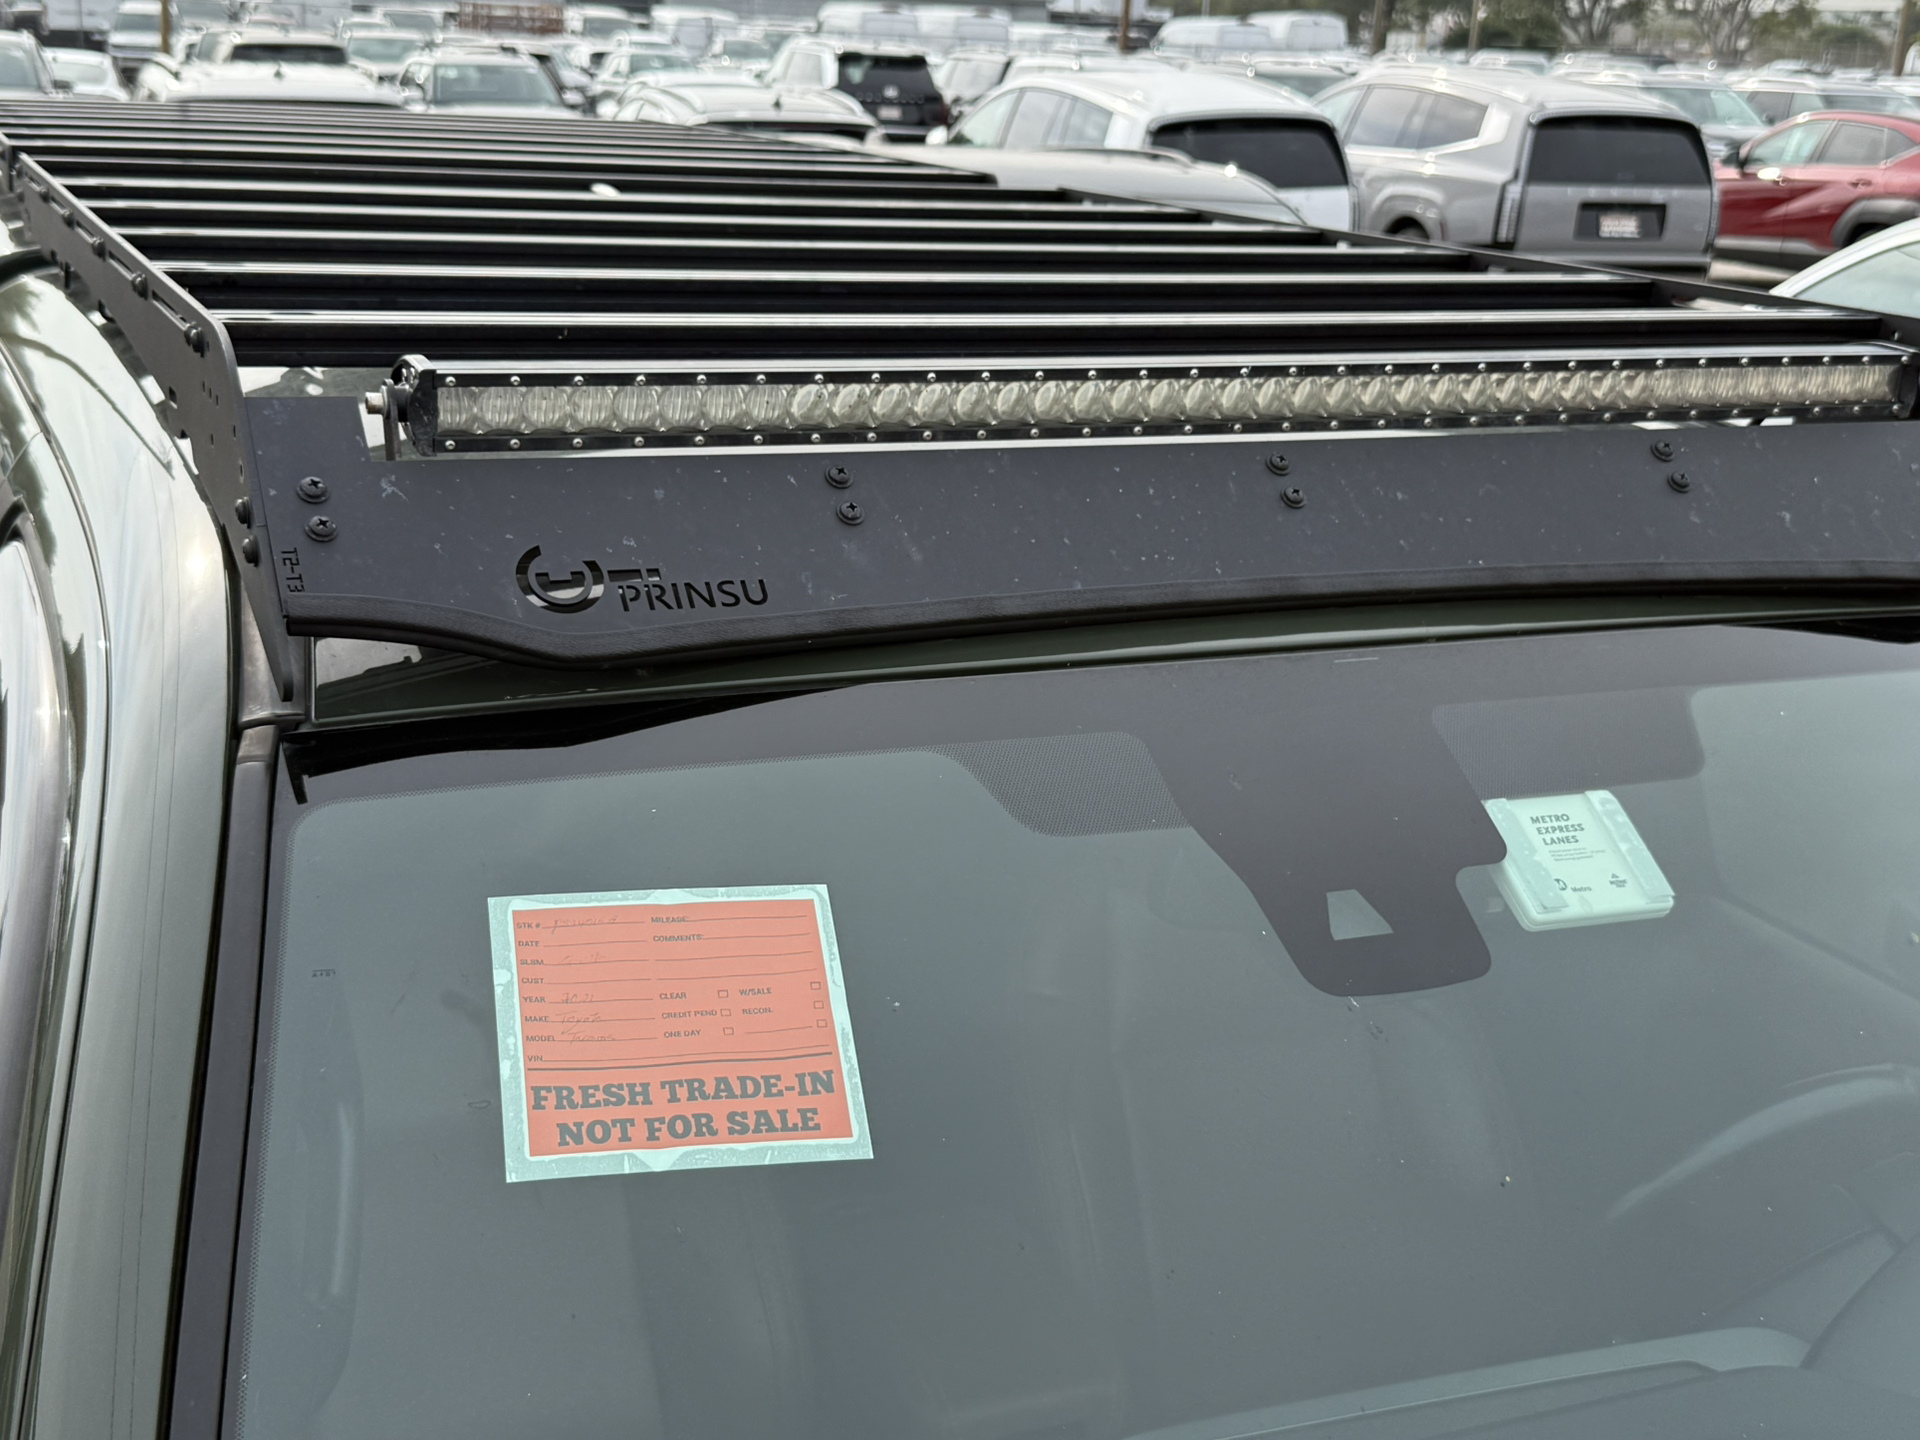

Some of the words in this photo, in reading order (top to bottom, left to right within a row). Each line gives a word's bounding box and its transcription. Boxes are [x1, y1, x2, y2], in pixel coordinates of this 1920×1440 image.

[617, 579, 769, 612] PRINSU
[1530, 813, 1570, 825] METRO
[1536, 823, 1585, 835] EXPRESS
[1542, 835, 1579, 846] LANES
[516, 921, 533, 929] STK
[659, 992, 687, 1000] CLEAR
[739, 987, 772, 996] W/SALE
[661, 1011, 692, 1019] CREDIT
[694, 1009, 717, 1017] PEND
[664, 1030, 682, 1038] ONE
[684, 1029, 701, 1037] DAY
[530, 1082, 653, 1110] FRESH
[660, 1069, 835, 1104] TRADE-IN
[556, 1117, 636, 1147] NOT
[644, 1113, 719, 1141] FOR
[726, 1108, 821, 1137] SALE
